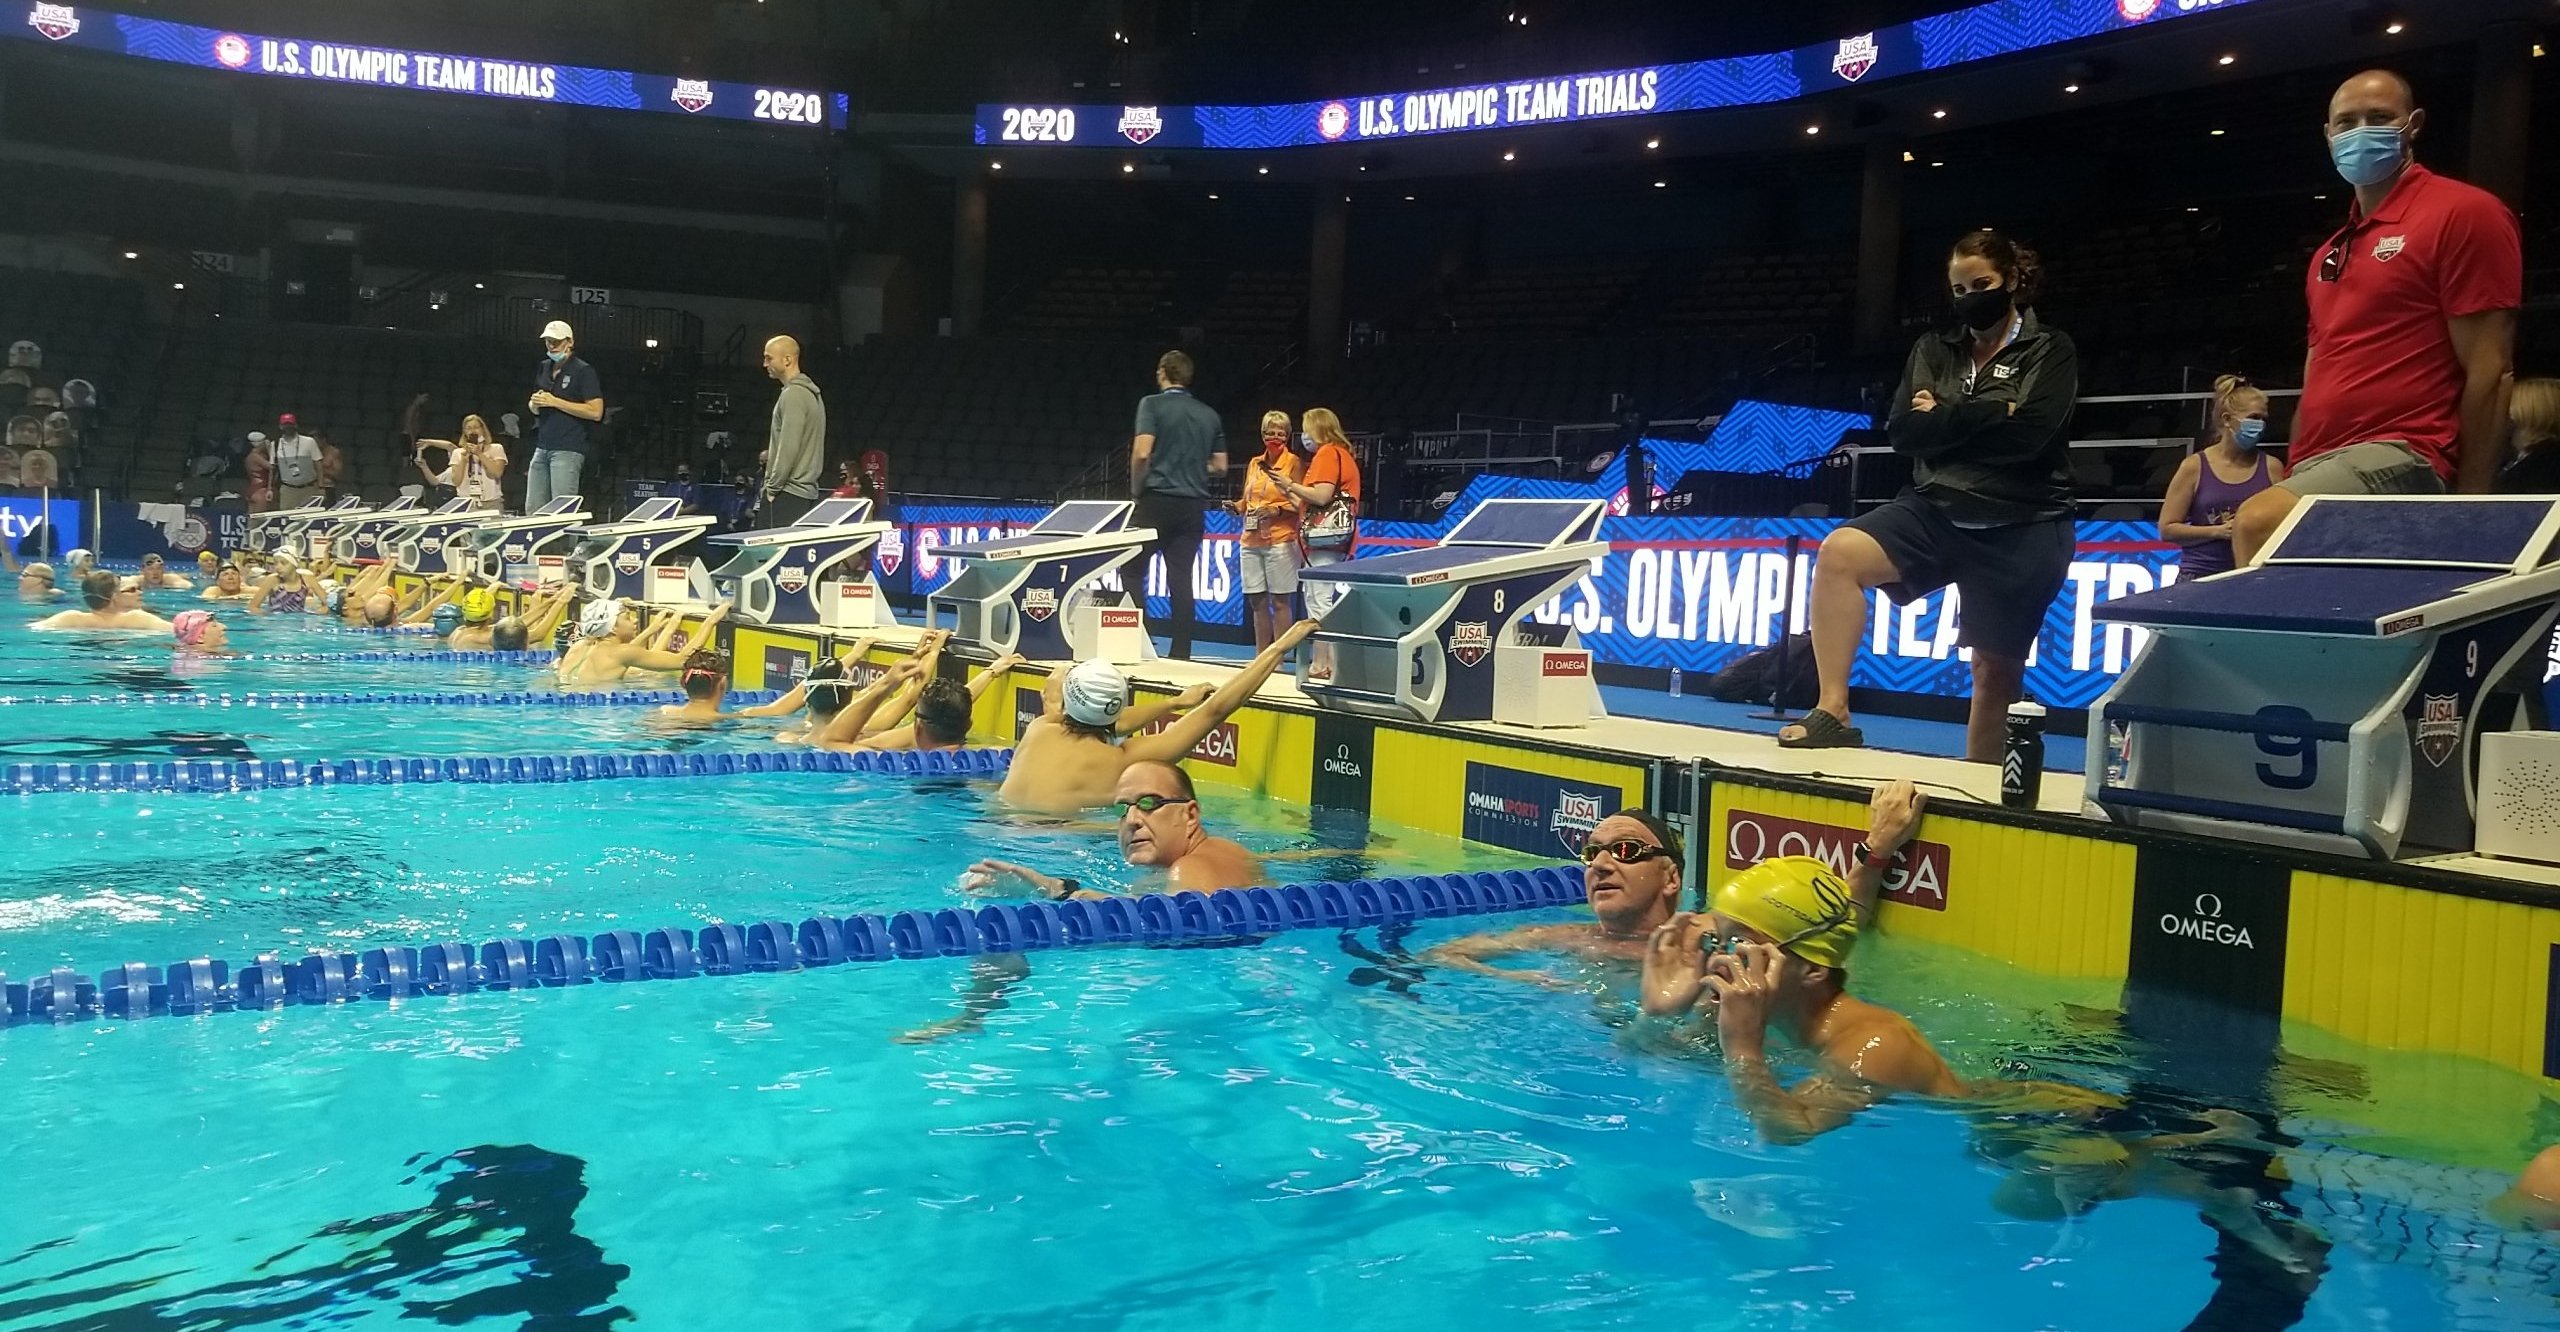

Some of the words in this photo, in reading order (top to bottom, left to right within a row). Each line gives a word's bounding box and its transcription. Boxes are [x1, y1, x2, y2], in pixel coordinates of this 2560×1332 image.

[1843, 41, 1868, 56] USA
[262, 40, 305, 75] U.S.
[311, 45, 408, 84] OLYMPIC
[415, 55, 475, 91] TEAM
[481, 61, 556, 98] TRIALS
[681, 83, 703, 93] USA
[1359, 97, 1399, 137] U.S.
[1403, 87, 1498, 133] OLYMPIC
[1506, 81, 1568, 123] TEAM
[1576, 70, 1657, 116] TRIALS
[1129, 112, 1152, 122] USA
[575, 288, 606, 304] 125
[0, 506, 44, 538] ty
[323, 520, 329, 528] 1
[374, 523, 382, 532] 2
[440, 526, 448, 536] 3
[525, 531, 534, 542] 4
[642, 537, 652, 550] 5
[807, 548, 817, 563] 6
[783, 570, 801, 578] USA
[1059, 564, 1069, 583] 7
[1422, 573, 1446, 583] OMEGA
[850, 588, 872, 596] OMEGA
[1030, 591, 1051, 602] USA
[1626, 548, 1816, 647] OLYMPI
[1493, 588, 1506, 614] 8
[1111, 616, 1138, 624] OMEGA
[2396, 616, 2420, 630] OMEGA
[1459, 627, 1484, 640] USA
[1452, 638, 1488, 648] SWIMMING
[1555, 660, 1586, 670] OMEGA
[2465, 640, 2479, 678] 9
[2427, 703, 2453, 722] USA
[2255, 704, 2318, 790] 9
[1324, 757, 1362, 778] OMEGA
[1468, 806, 1539, 828] COMMISSION
[1564, 798, 1596, 821] USA
[1777, 831, 1944, 900] OMGA
[2160, 913, 2255, 950] OMEGA
